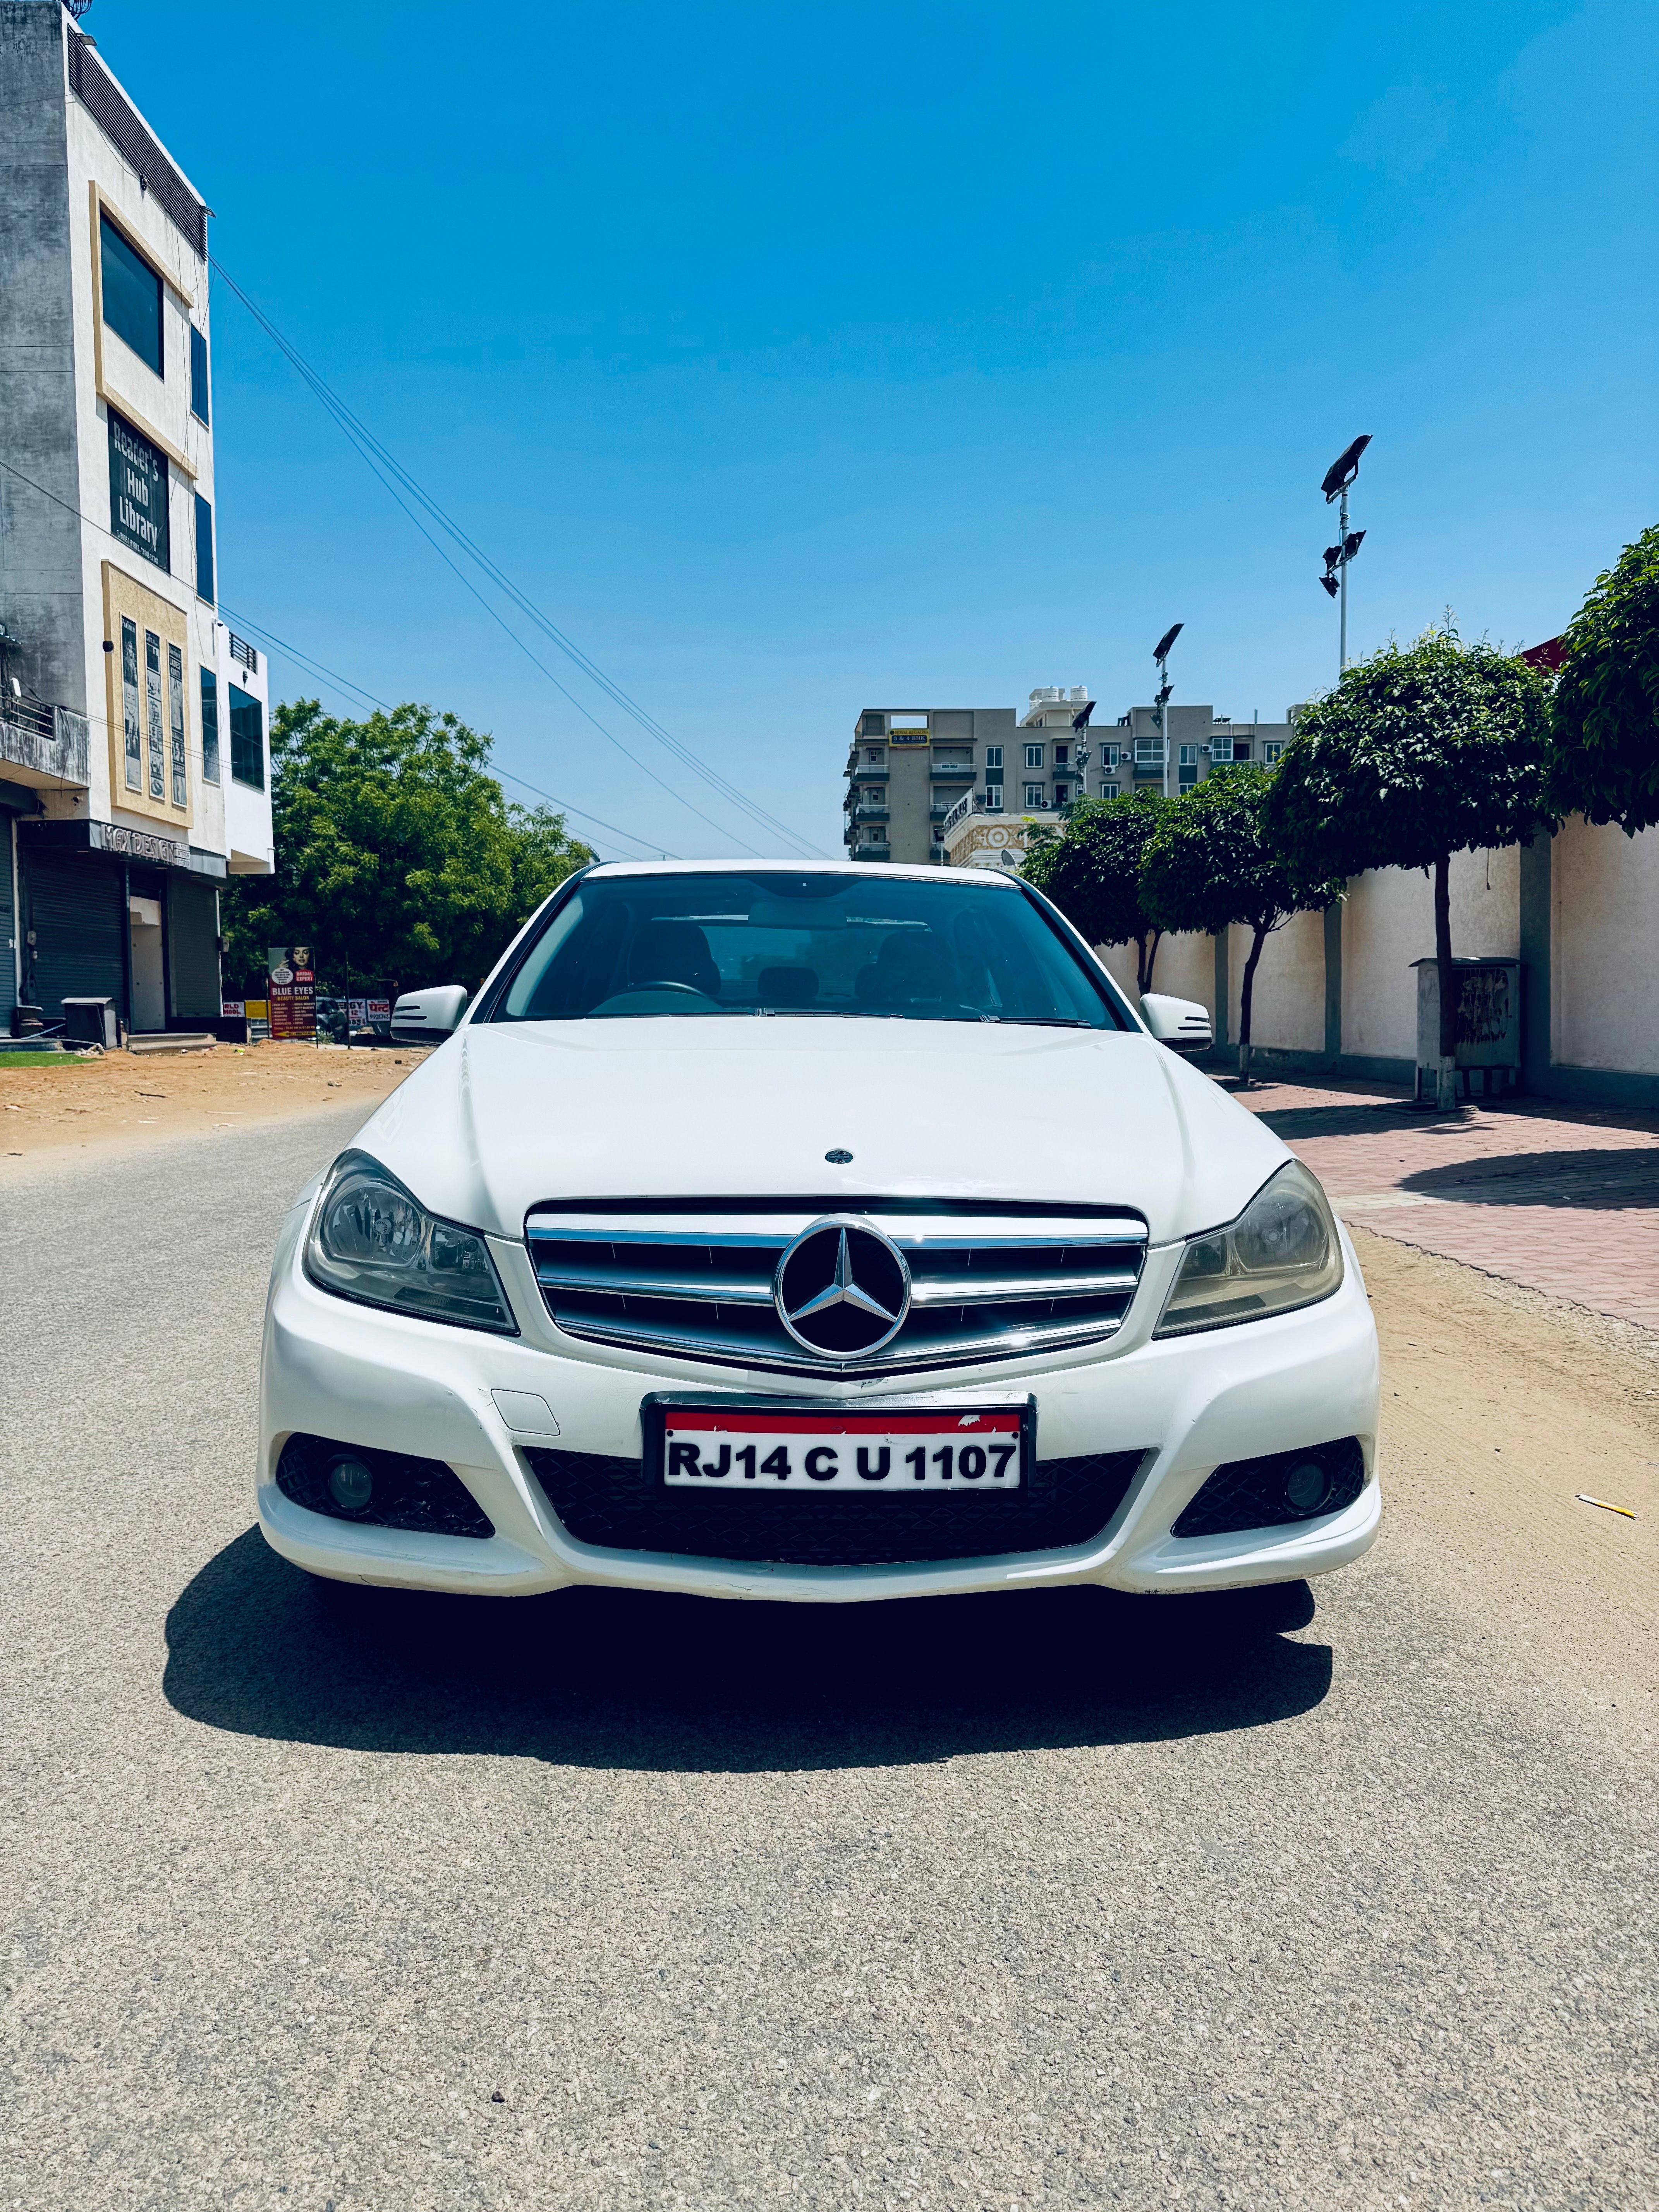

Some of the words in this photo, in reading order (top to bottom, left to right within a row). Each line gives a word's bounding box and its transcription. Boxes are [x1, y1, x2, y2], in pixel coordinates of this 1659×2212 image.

[114, 421, 158, 482] Reader's
[127, 467, 148, 507] Hub
[119, 495, 157, 552] Library
[101, 824, 132, 854] MAX
[132, 832, 175, 864] DESIGN
[272, 987, 292, 996] BLUE
[294, 986, 314, 995] EYES
[668, 1442, 792, 1480] RJ14
[805, 1447, 839, 1481] C
[856, 1447, 890, 1480] U
[905, 1444, 1017, 1480] 1107
